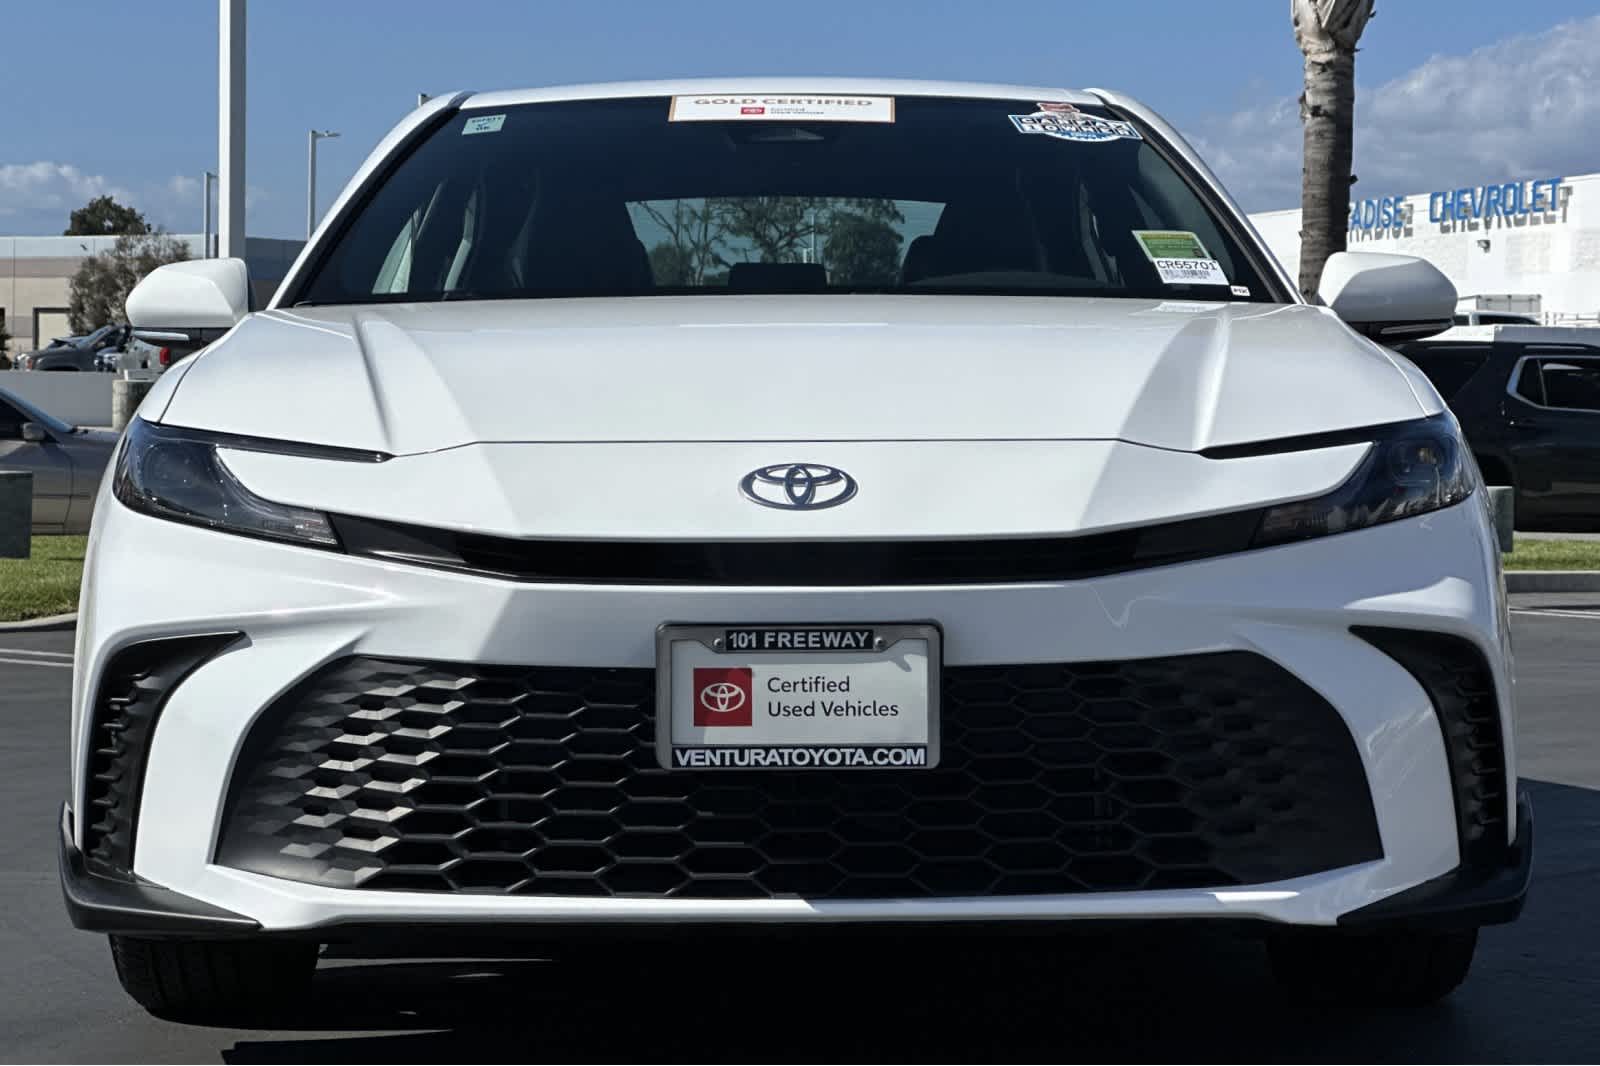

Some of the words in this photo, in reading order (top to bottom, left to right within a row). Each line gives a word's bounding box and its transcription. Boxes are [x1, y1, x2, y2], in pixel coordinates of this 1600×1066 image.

[762, 98, 873, 106] CERTIFIED
[1429, 178, 1562, 223] CHEVROLET
[1156, 260, 1218, 271] CR55701
[729, 632, 757, 648] 101
[764, 632, 869, 648] FREEWAY
[767, 676, 850, 693] Certified
[767, 701, 821, 717] Used
[822, 701, 899, 717] Vehicles
[675, 748, 925, 766] VENTURATOYOTA.COM
